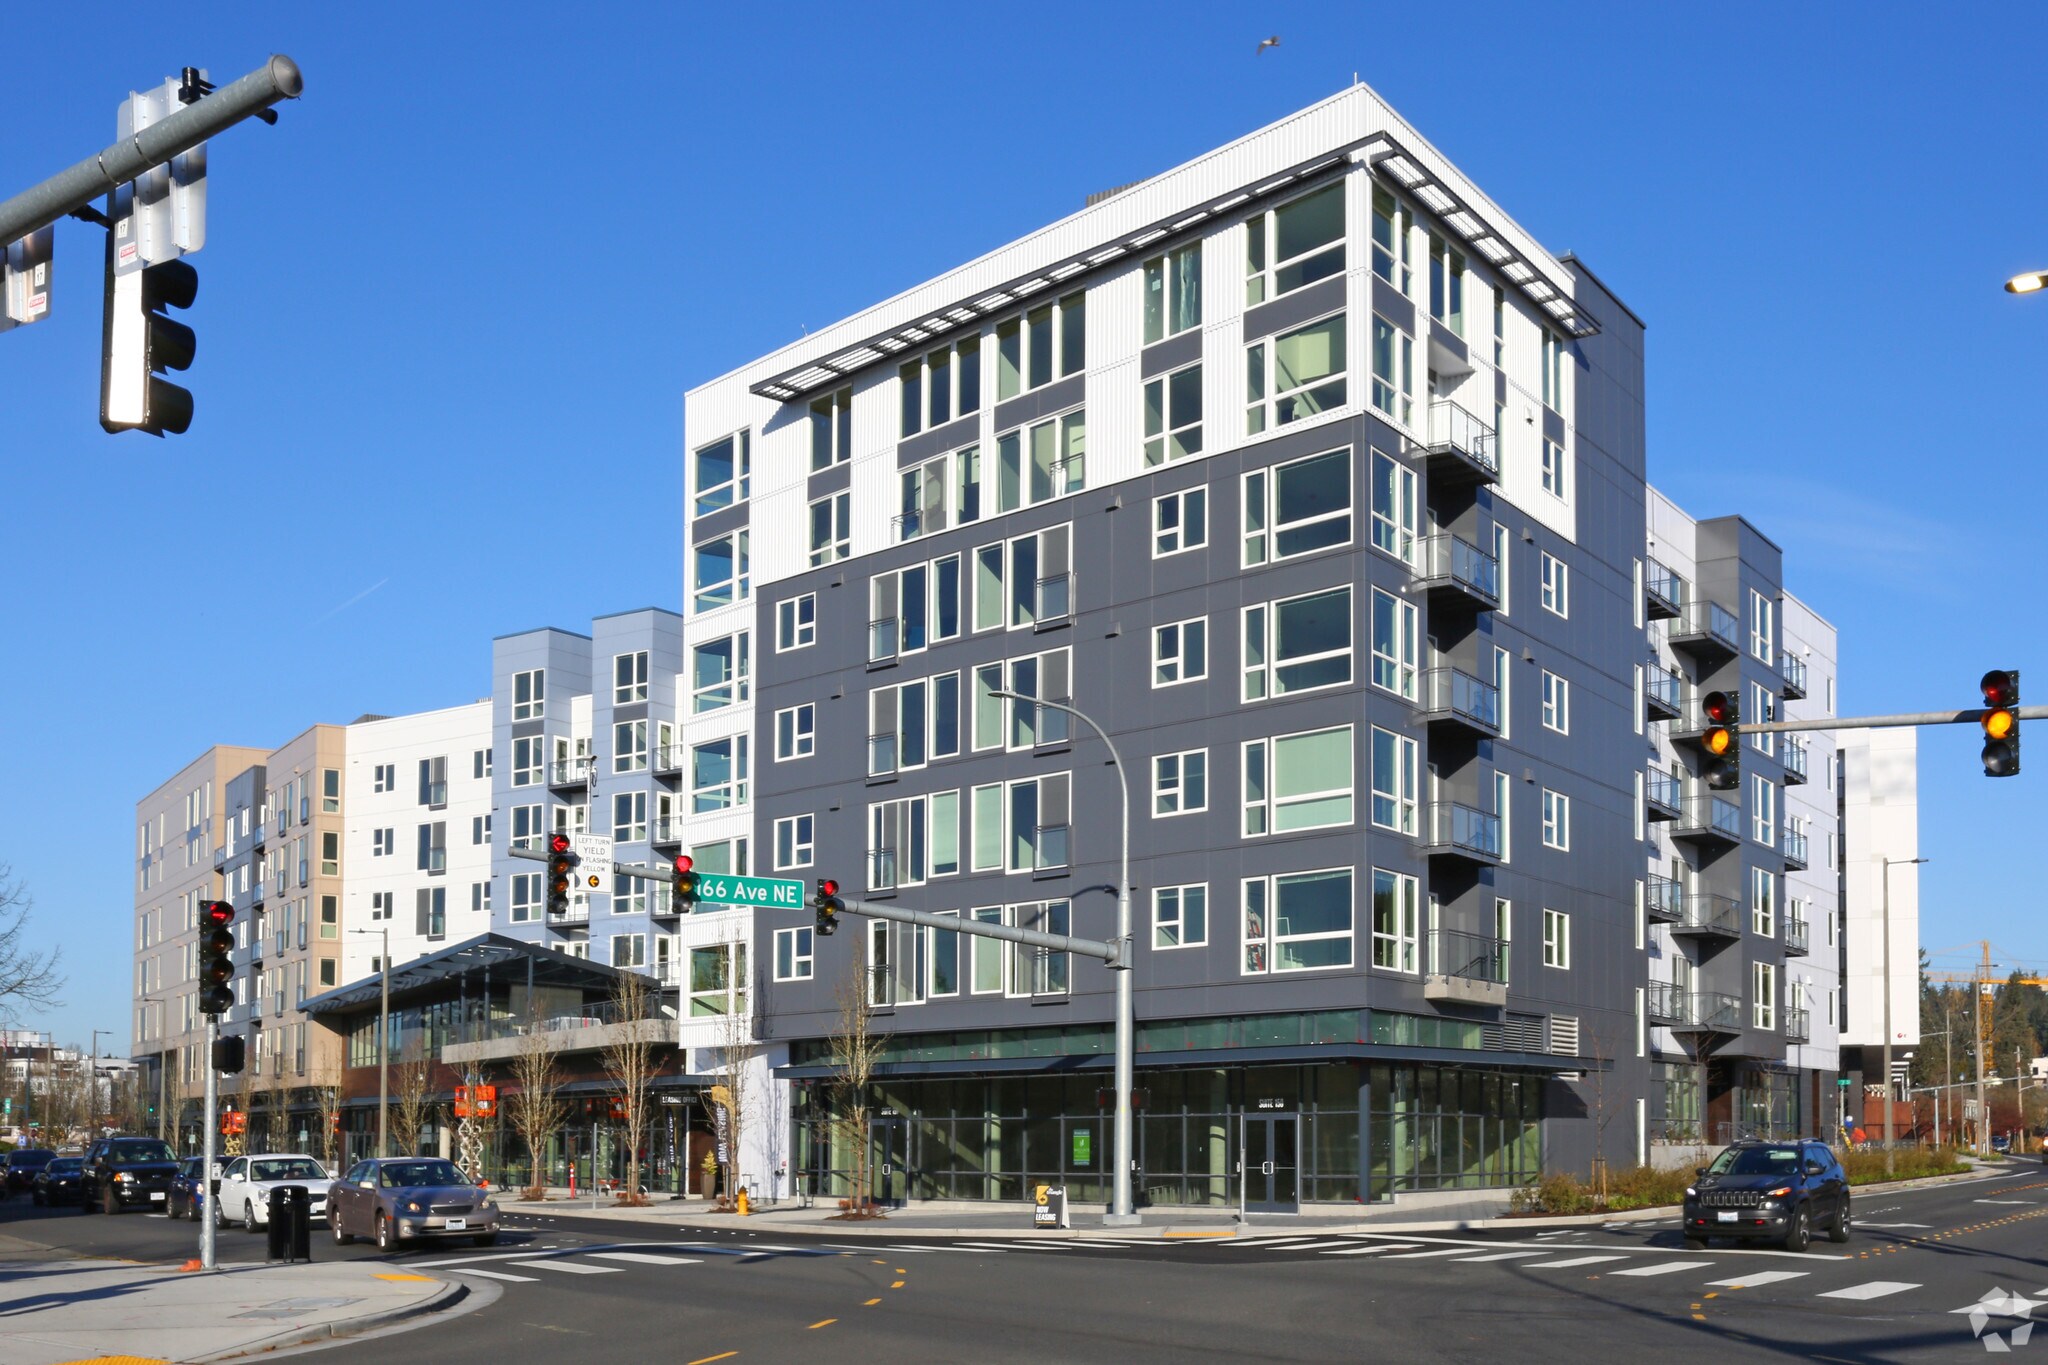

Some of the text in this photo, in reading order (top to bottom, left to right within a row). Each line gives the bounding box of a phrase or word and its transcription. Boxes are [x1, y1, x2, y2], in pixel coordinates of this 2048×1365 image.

[584, 847, 605, 855] YIELD
[733, 882, 767, 901] Ave
[773, 884, 797, 903] NE
[1258, 1098, 1274, 1108] SUITE
[717, 1143, 728, 1163] NOW
[1035, 1213, 1057, 1221] LEASING
